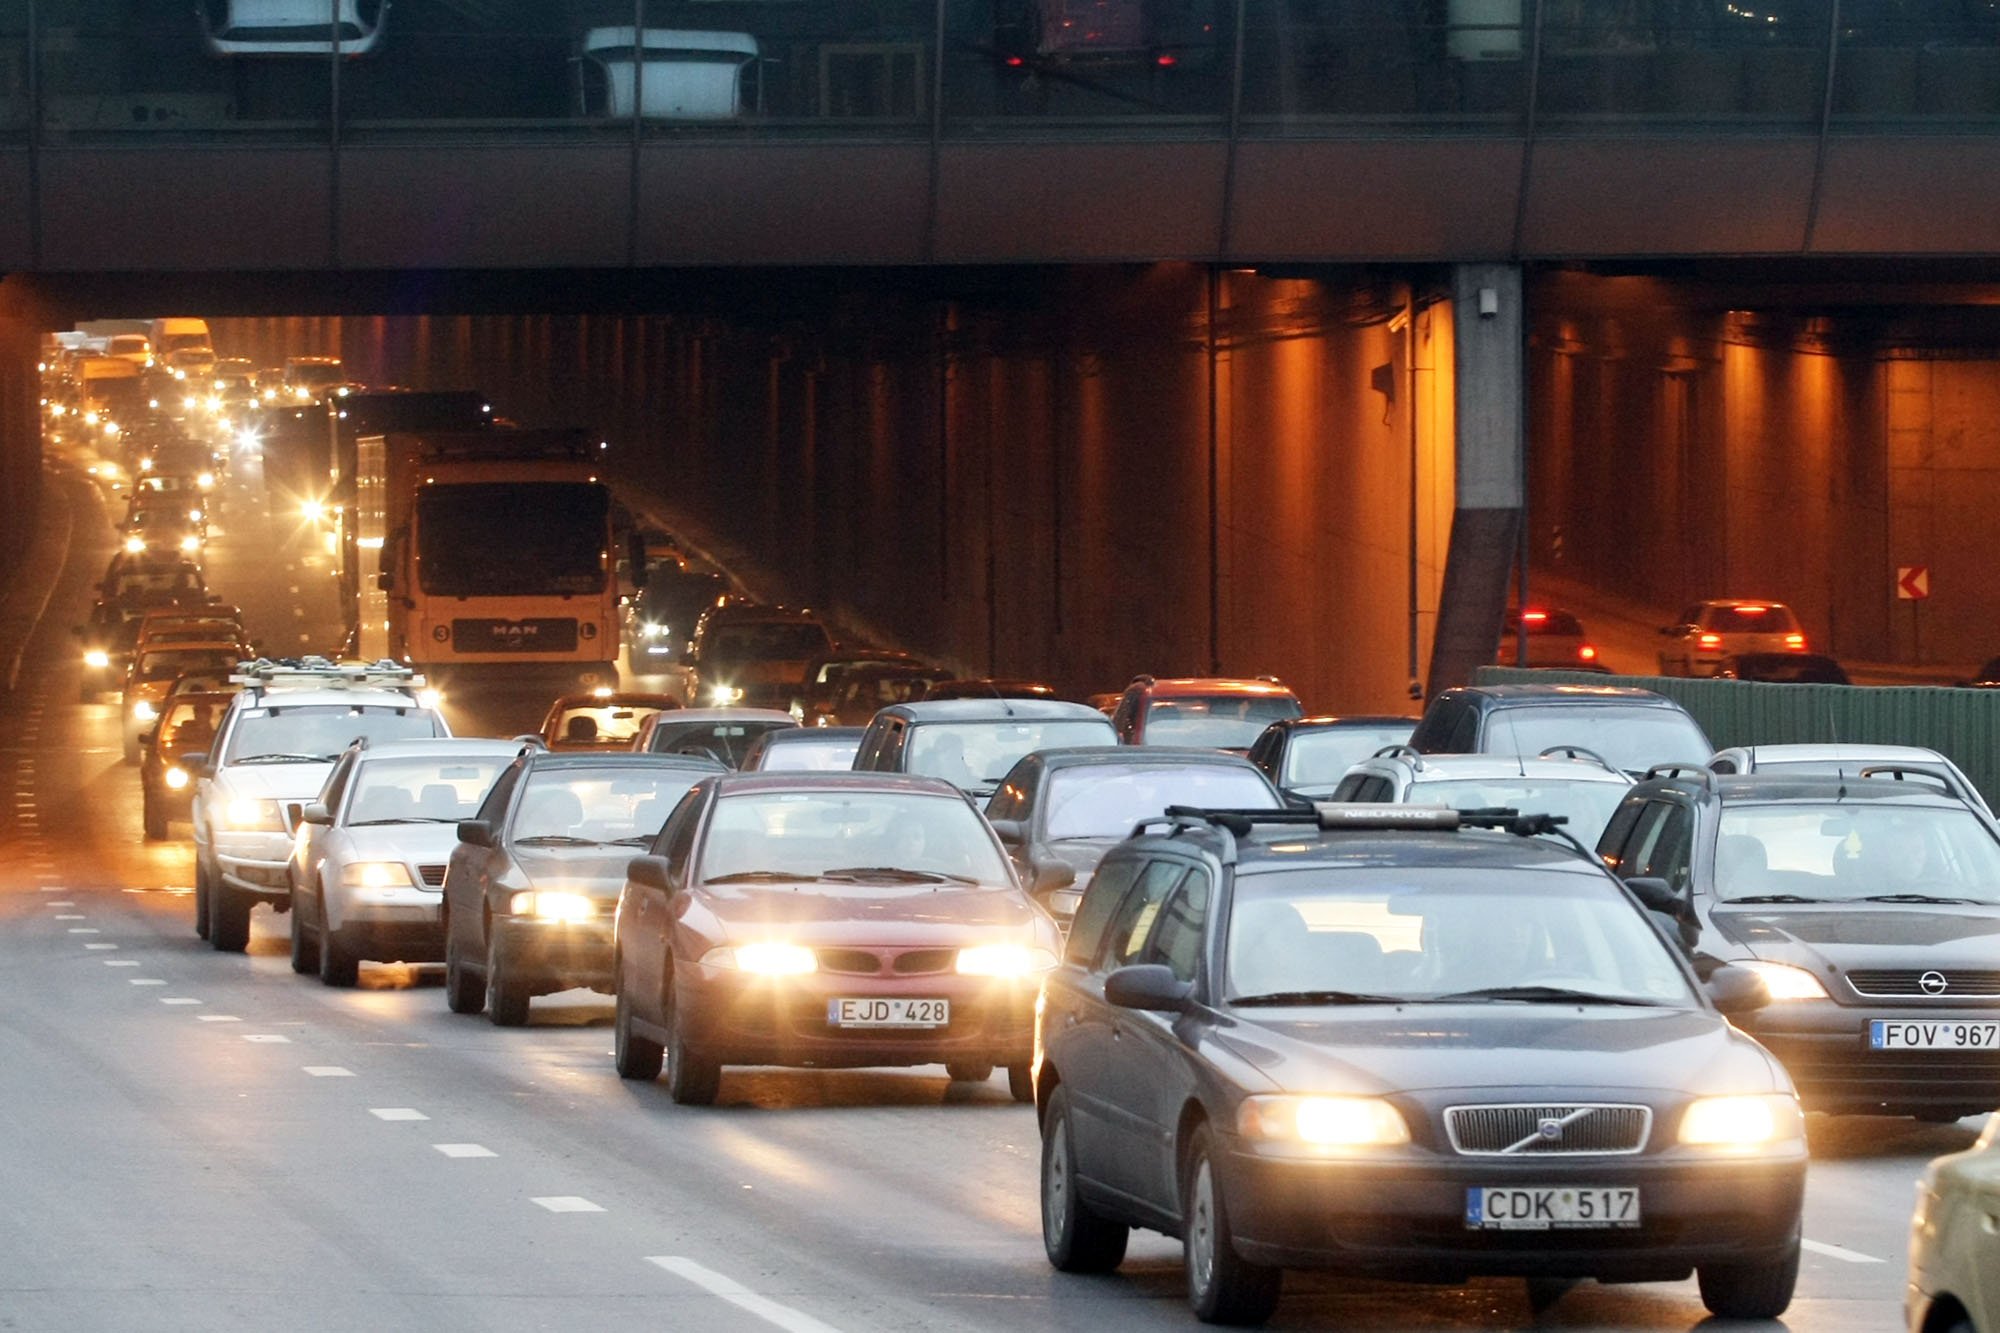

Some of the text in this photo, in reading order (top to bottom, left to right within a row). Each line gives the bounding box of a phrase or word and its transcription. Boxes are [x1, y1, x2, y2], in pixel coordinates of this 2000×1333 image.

[493, 626, 538, 635] MAN
[841, 1001, 945, 1021] EJD 428
[1886, 1025, 1997, 1046] FOV 967
[1487, 1191, 1634, 1219] CDK 517
